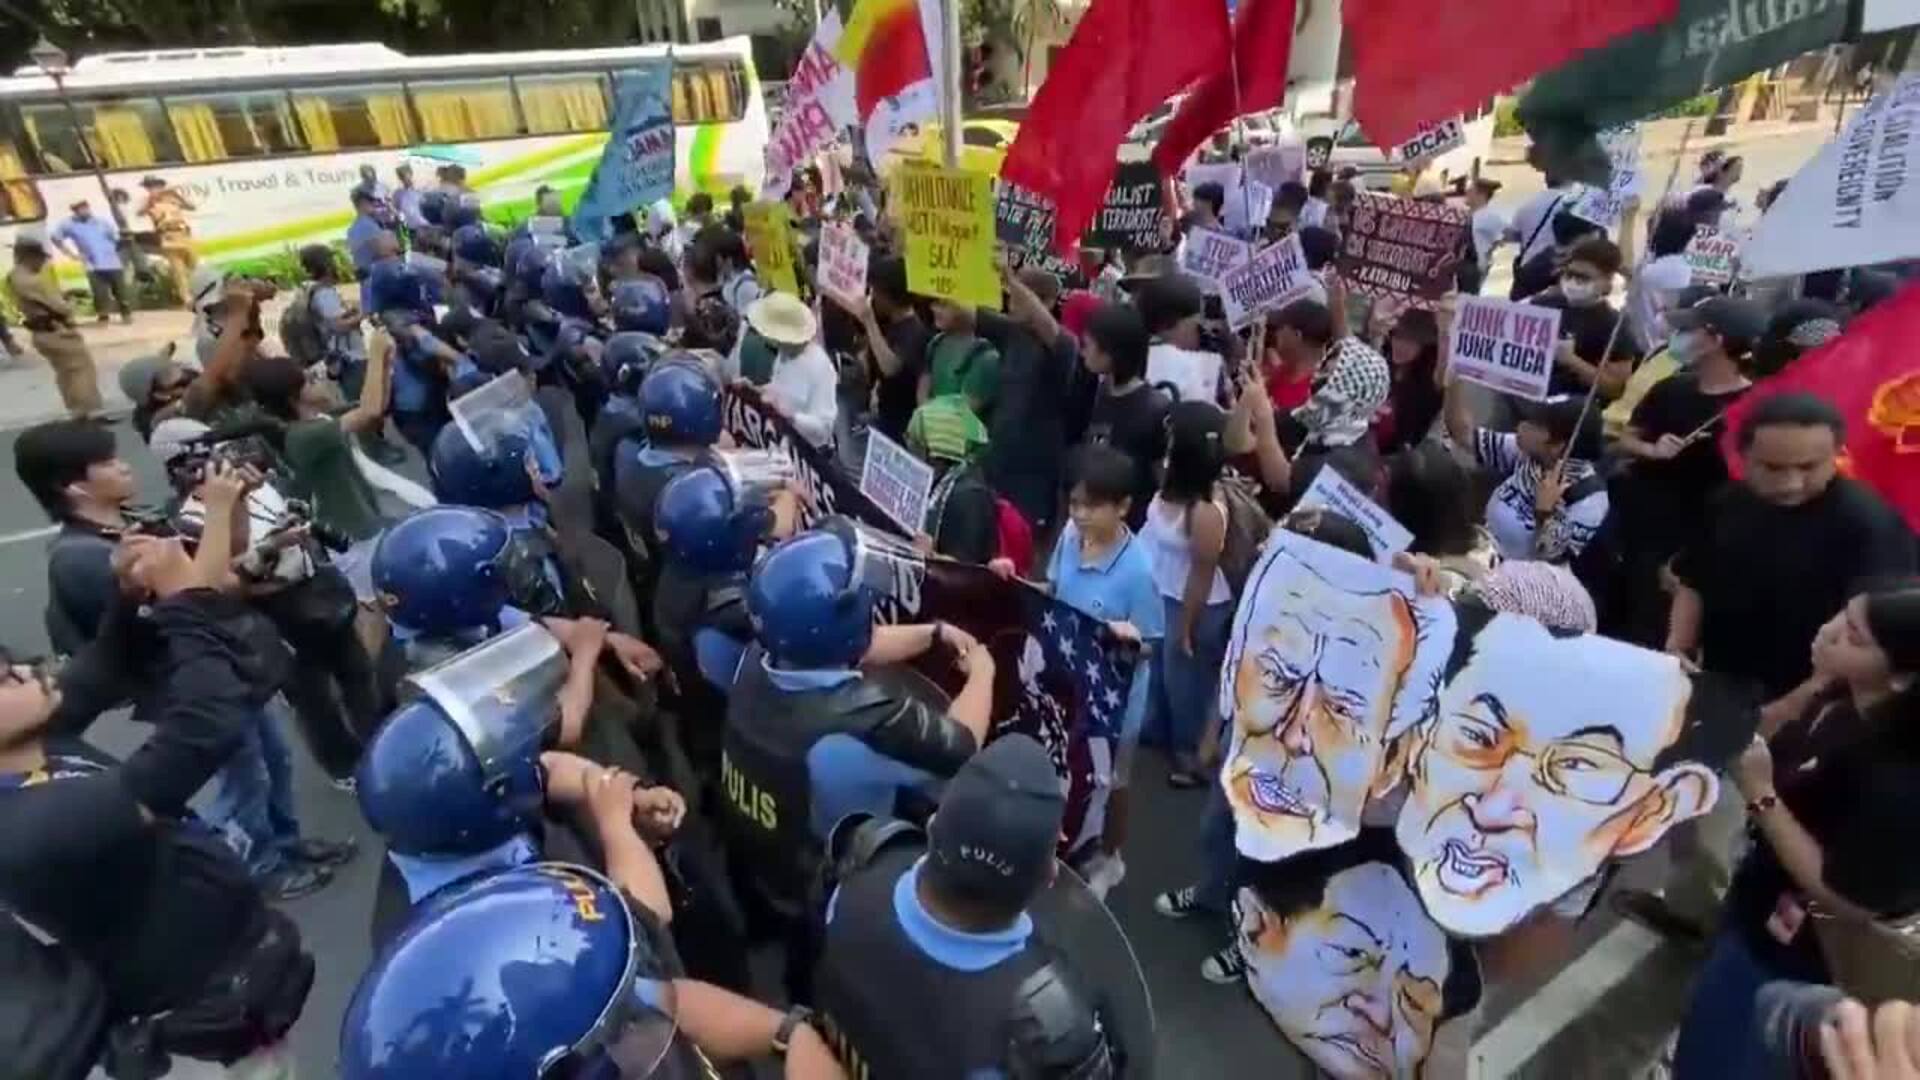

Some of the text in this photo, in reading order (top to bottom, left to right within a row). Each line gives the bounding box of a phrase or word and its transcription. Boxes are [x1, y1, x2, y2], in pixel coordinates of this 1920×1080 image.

[216, 172, 279, 193] Travel
[1695, 240, 1735, 257] WAR
[1459, 302, 1552, 349] JUNK VFA
[1456, 331, 1496, 363] JUNK
[1500, 341, 1546, 376] EDCA
